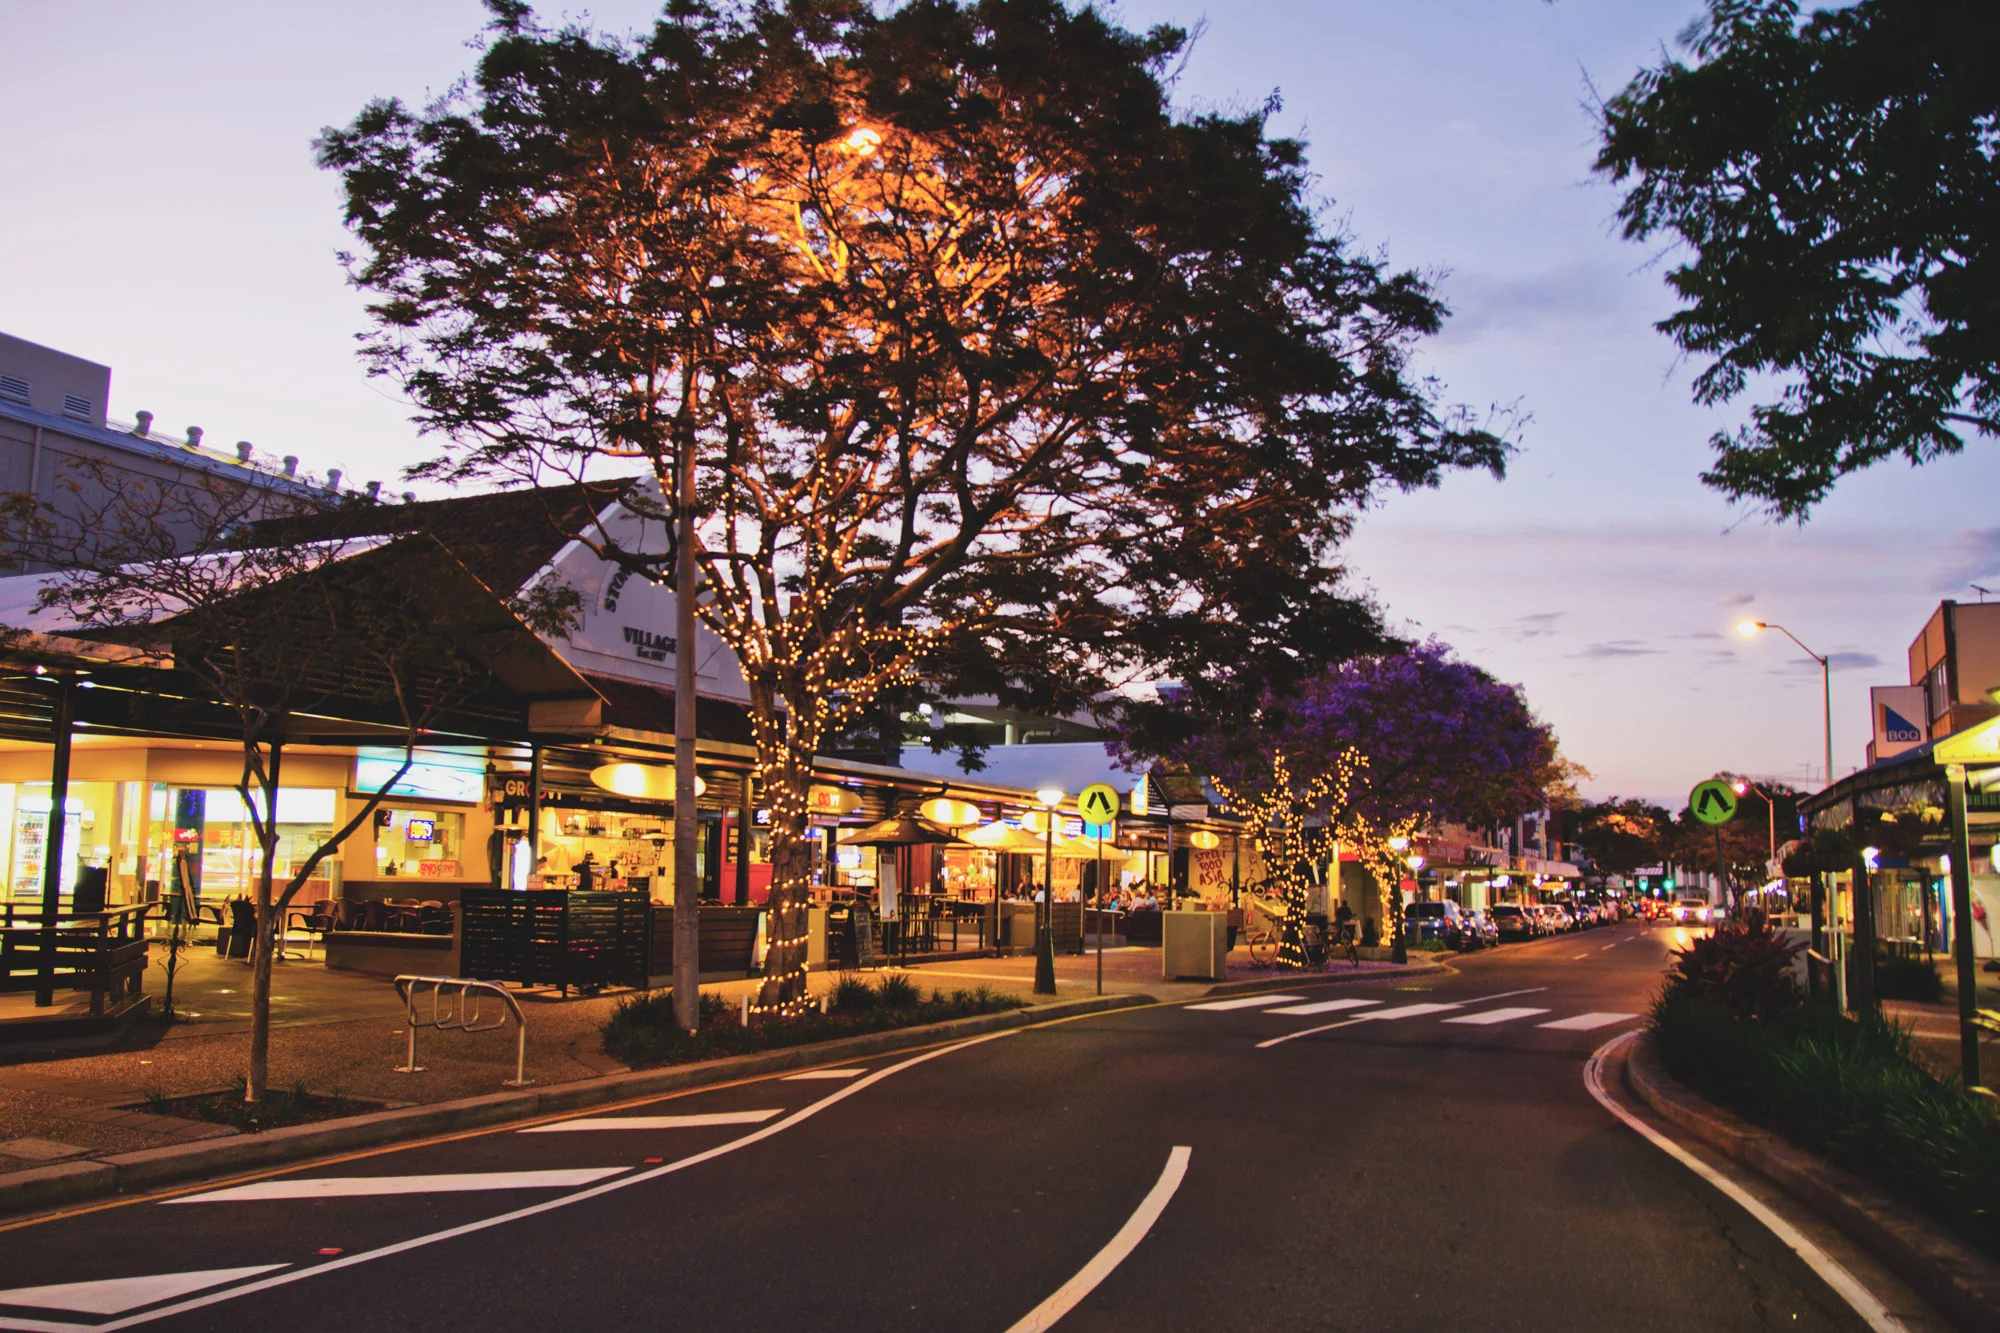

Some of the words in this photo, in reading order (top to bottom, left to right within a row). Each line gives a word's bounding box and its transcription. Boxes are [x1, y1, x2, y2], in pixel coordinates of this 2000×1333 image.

[623, 627, 677, 654] VILLAGE
[1889, 730, 1919, 741] BOQ
[1195, 850, 1226, 862] STREET
[1199, 859, 1223, 871] FOOD
